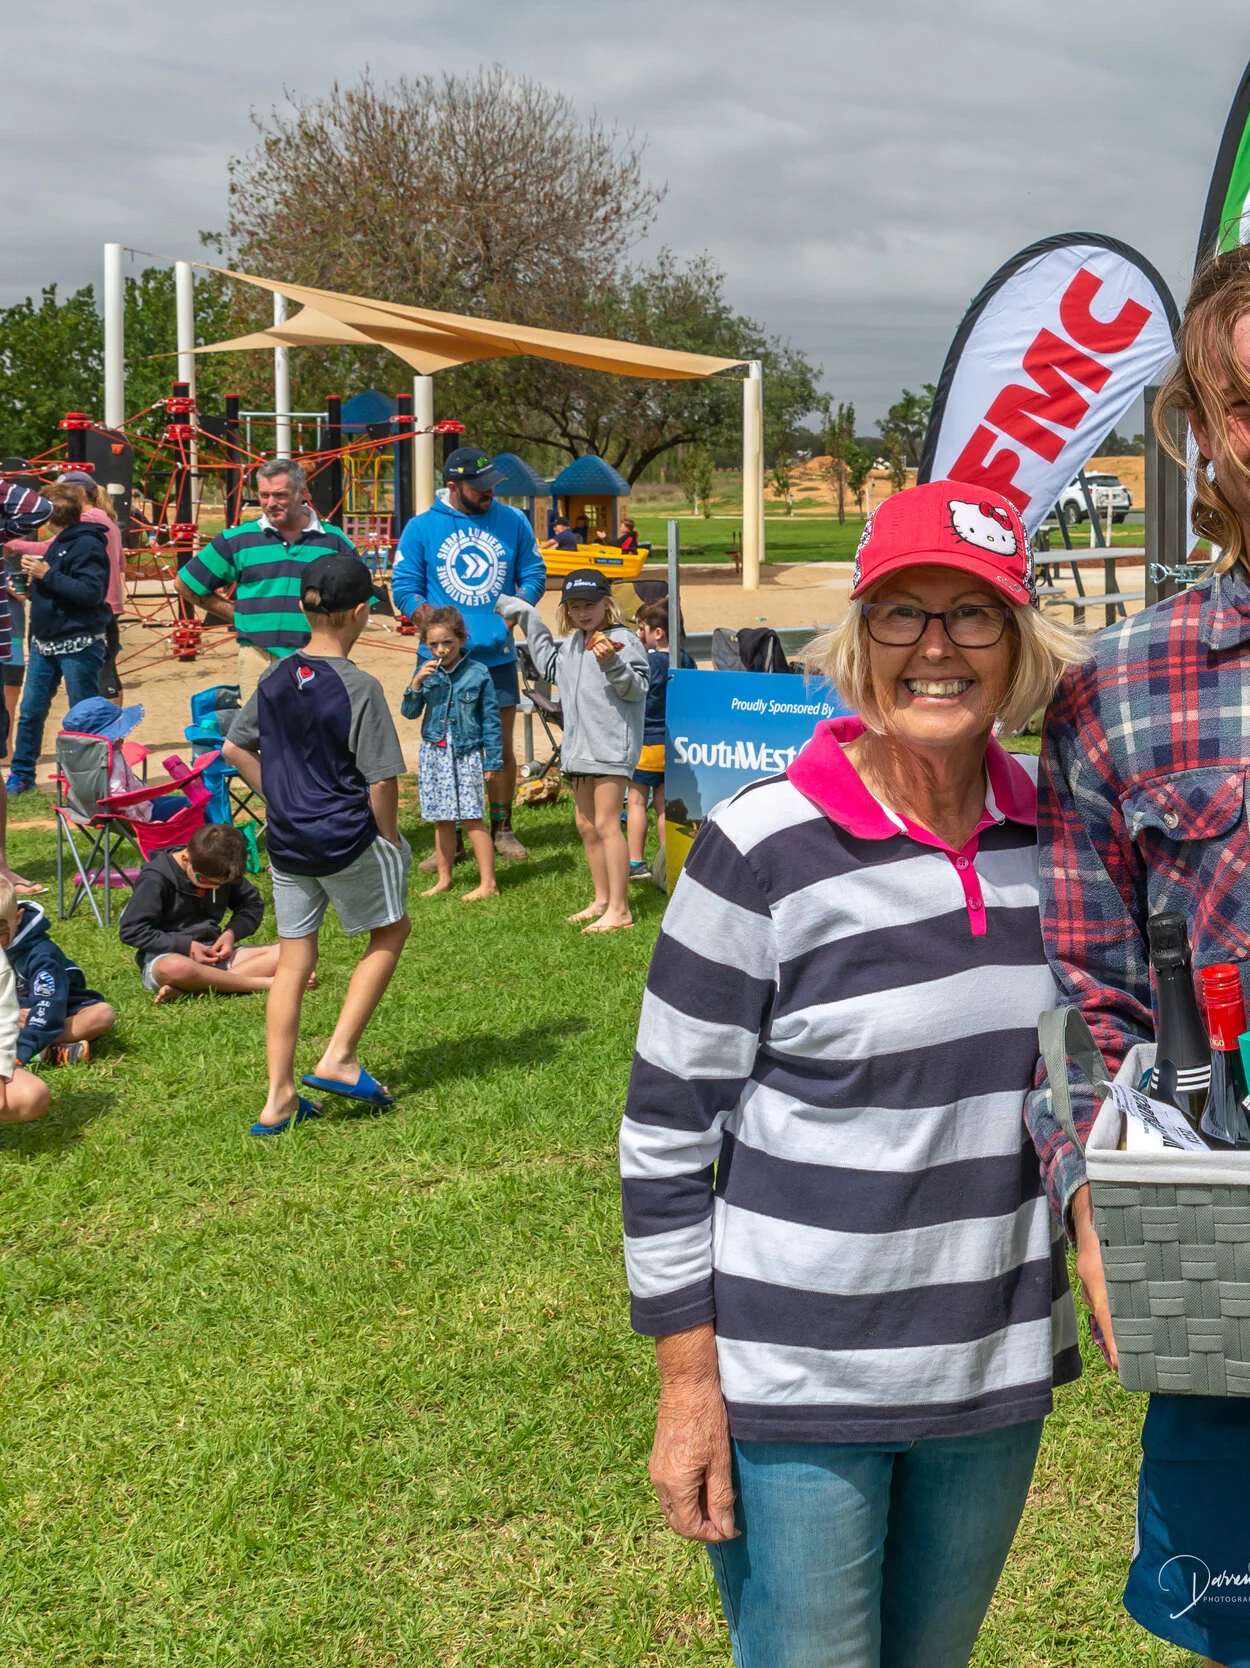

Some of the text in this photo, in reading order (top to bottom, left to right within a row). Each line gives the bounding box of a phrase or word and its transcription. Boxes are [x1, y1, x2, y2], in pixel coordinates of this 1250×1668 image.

[947, 267, 1152, 514] FMC
[436, 529, 466, 560] SIERRA
[490, 561, 508, 597] NOVOS
[731, 697, 834, 719] Proudly Sponsored By
